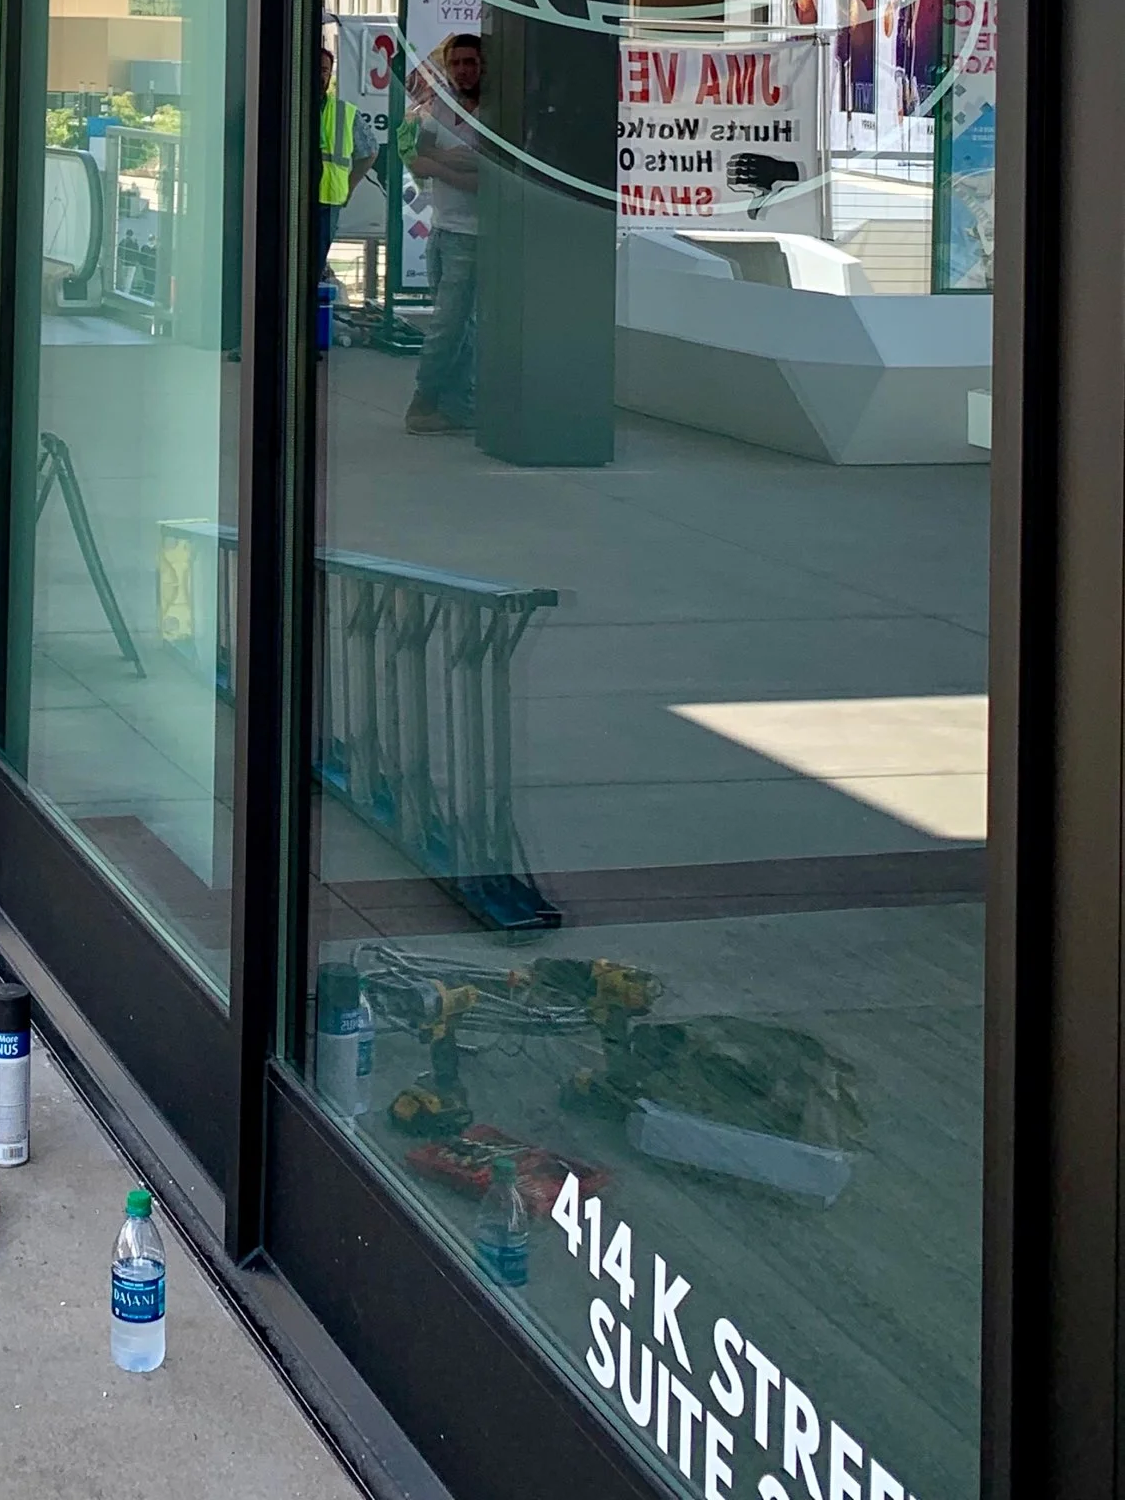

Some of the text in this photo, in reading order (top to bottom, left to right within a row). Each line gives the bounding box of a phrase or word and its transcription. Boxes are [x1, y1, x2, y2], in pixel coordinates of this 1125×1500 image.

[114, 1288, 154, 1307] DASANI
[551, 1172, 635, 1310] 414
[653, 1253, 692, 1374] K
[586, 1298, 734, 1500] SUITE
